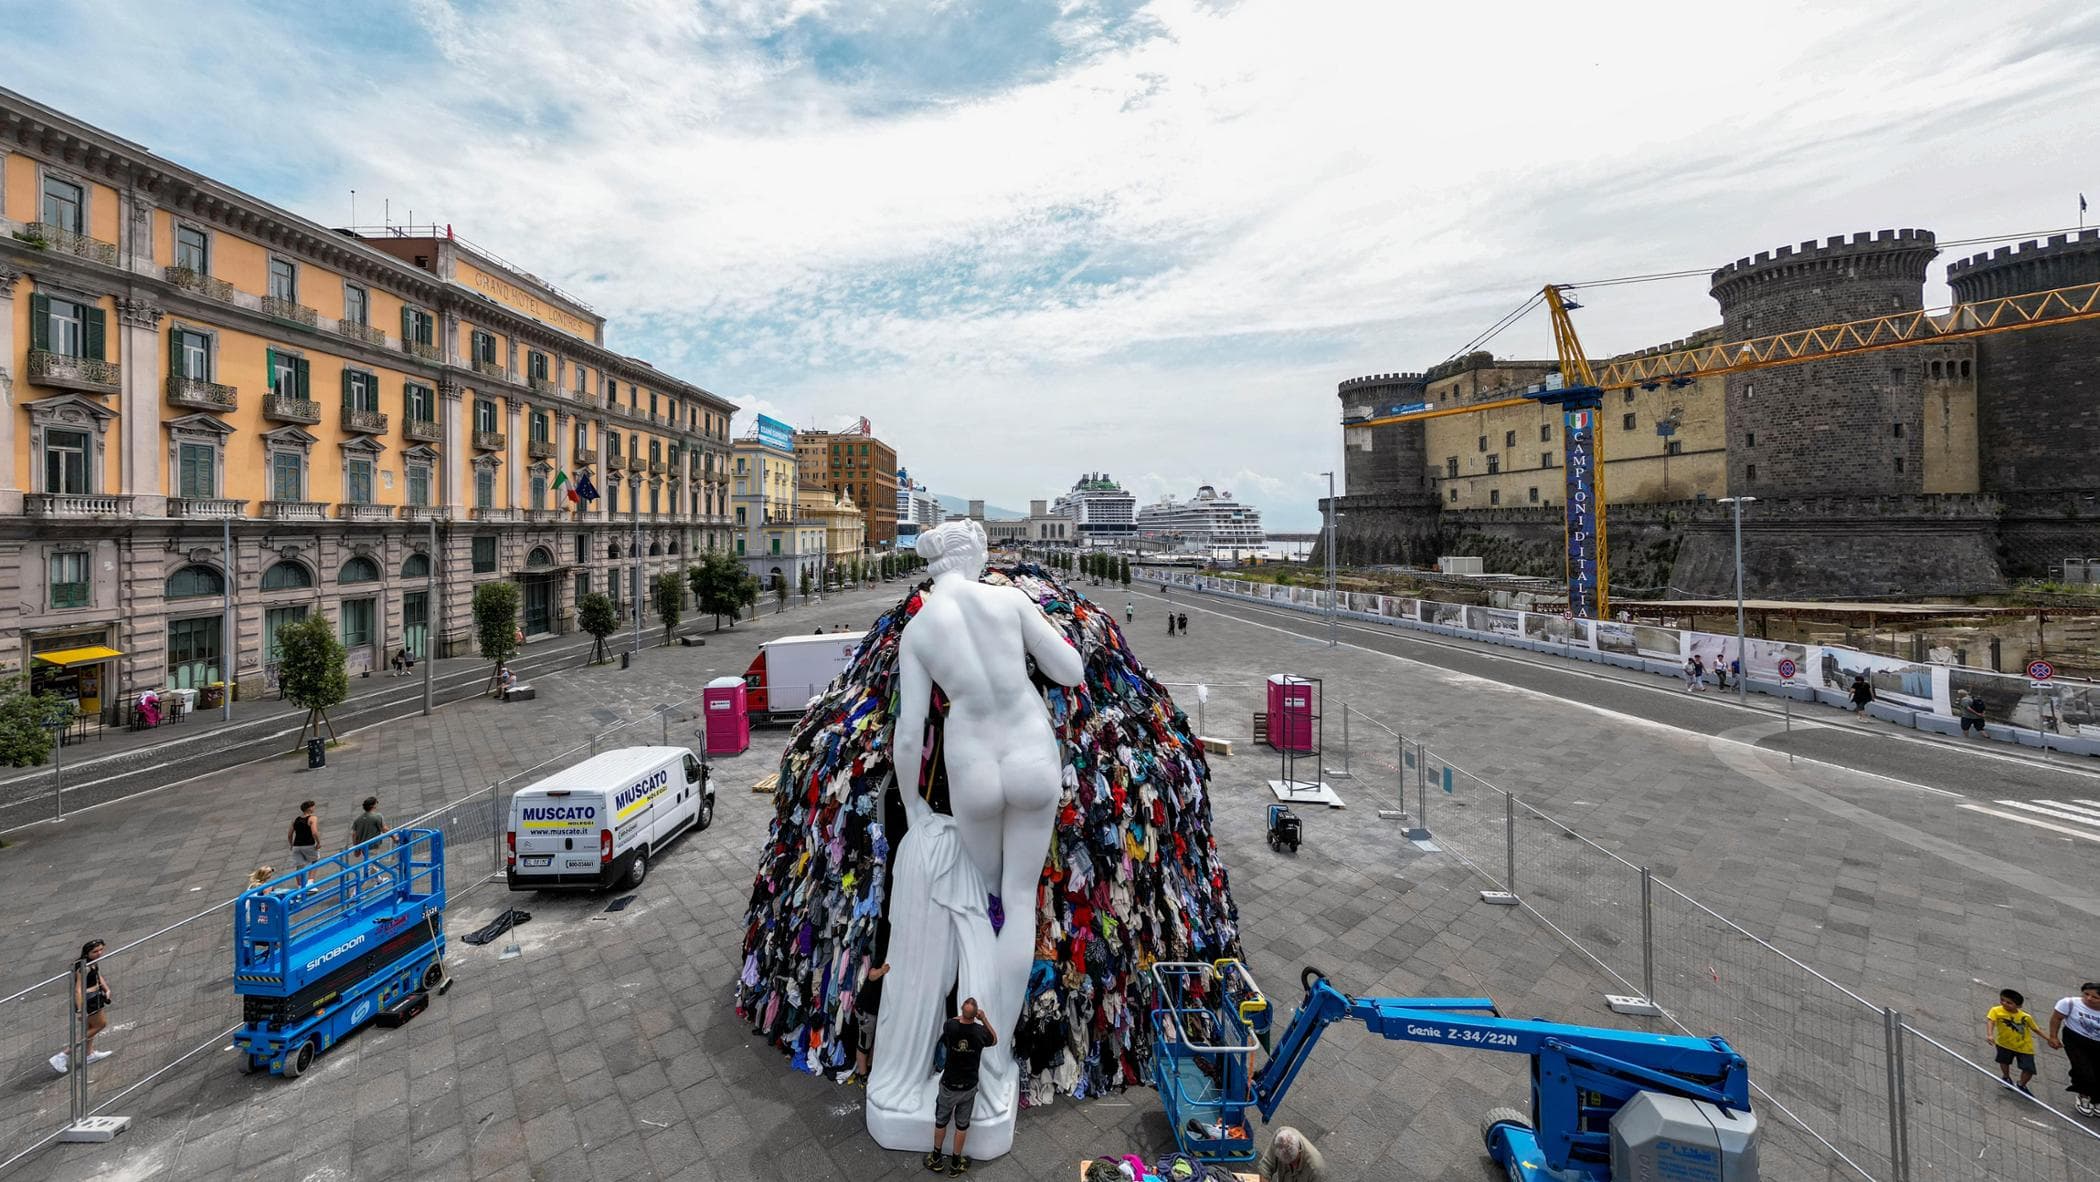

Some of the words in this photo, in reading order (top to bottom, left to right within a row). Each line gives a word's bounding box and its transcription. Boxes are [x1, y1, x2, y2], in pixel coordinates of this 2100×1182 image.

[474, 272, 509, 300] GRAND
[511, 289, 541, 315] HOTEL
[549, 310, 584, 333] LONDRES
[1573, 431, 1587, 526] CAMPIONI
[522, 806, 595, 821] MUSCATO
[306, 934, 365, 972] SINOBOOM
[1407, 1024, 1441, 1038] Genie
[1447, 1028, 1518, 1047] Z-34/22N
